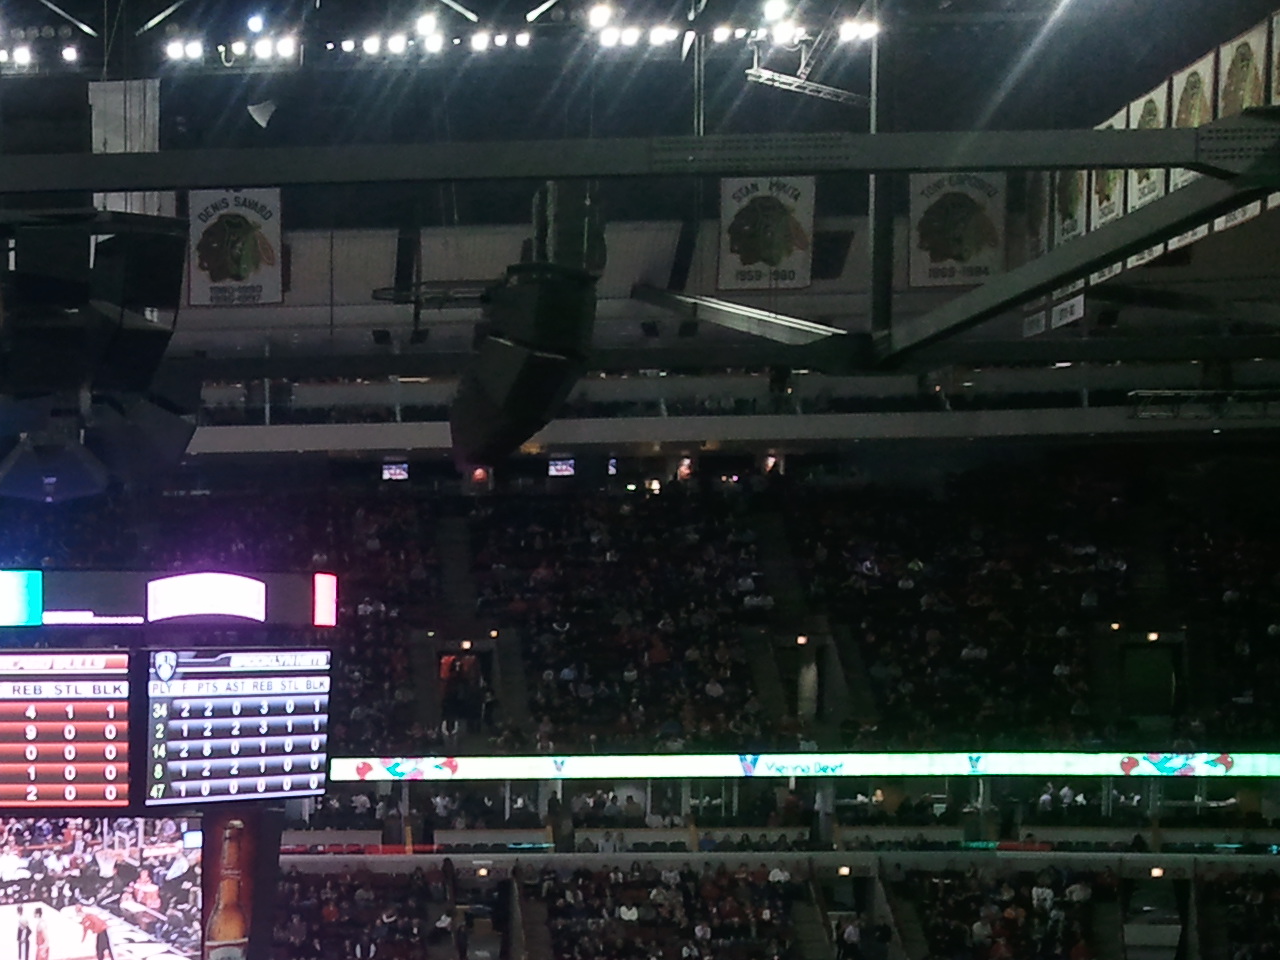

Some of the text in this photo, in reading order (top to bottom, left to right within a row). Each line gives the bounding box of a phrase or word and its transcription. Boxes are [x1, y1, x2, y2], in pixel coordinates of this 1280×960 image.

[198, 198, 230, 224] DENIS
[13, 684, 42, 695] REB
[55, 684, 81, 695] STL
[93, 684, 122, 695] BLK
[153, 683, 172, 693] PLY
[198, 681, 217, 692] PTS
[226, 681, 244, 691] AST
[253, 681, 272, 690] REB
[281, 680, 298, 690] STL
[306, 678, 325, 688] BLK
[26, 706, 37, 719] 4
[26, 726, 37, 740] 9
[65, 726, 76, 740] 0
[105, 726, 116, 740] 0
[26, 746, 37, 760] 0
[65, 746, 76, 760] 0
[105, 746, 116, 760] 0
[65, 766, 76, 780] 0
[105, 766, 116, 780] 0
[26, 786, 37, 801] 2
[65, 786, 76, 801] 0
[105, 786, 116, 801] 0
